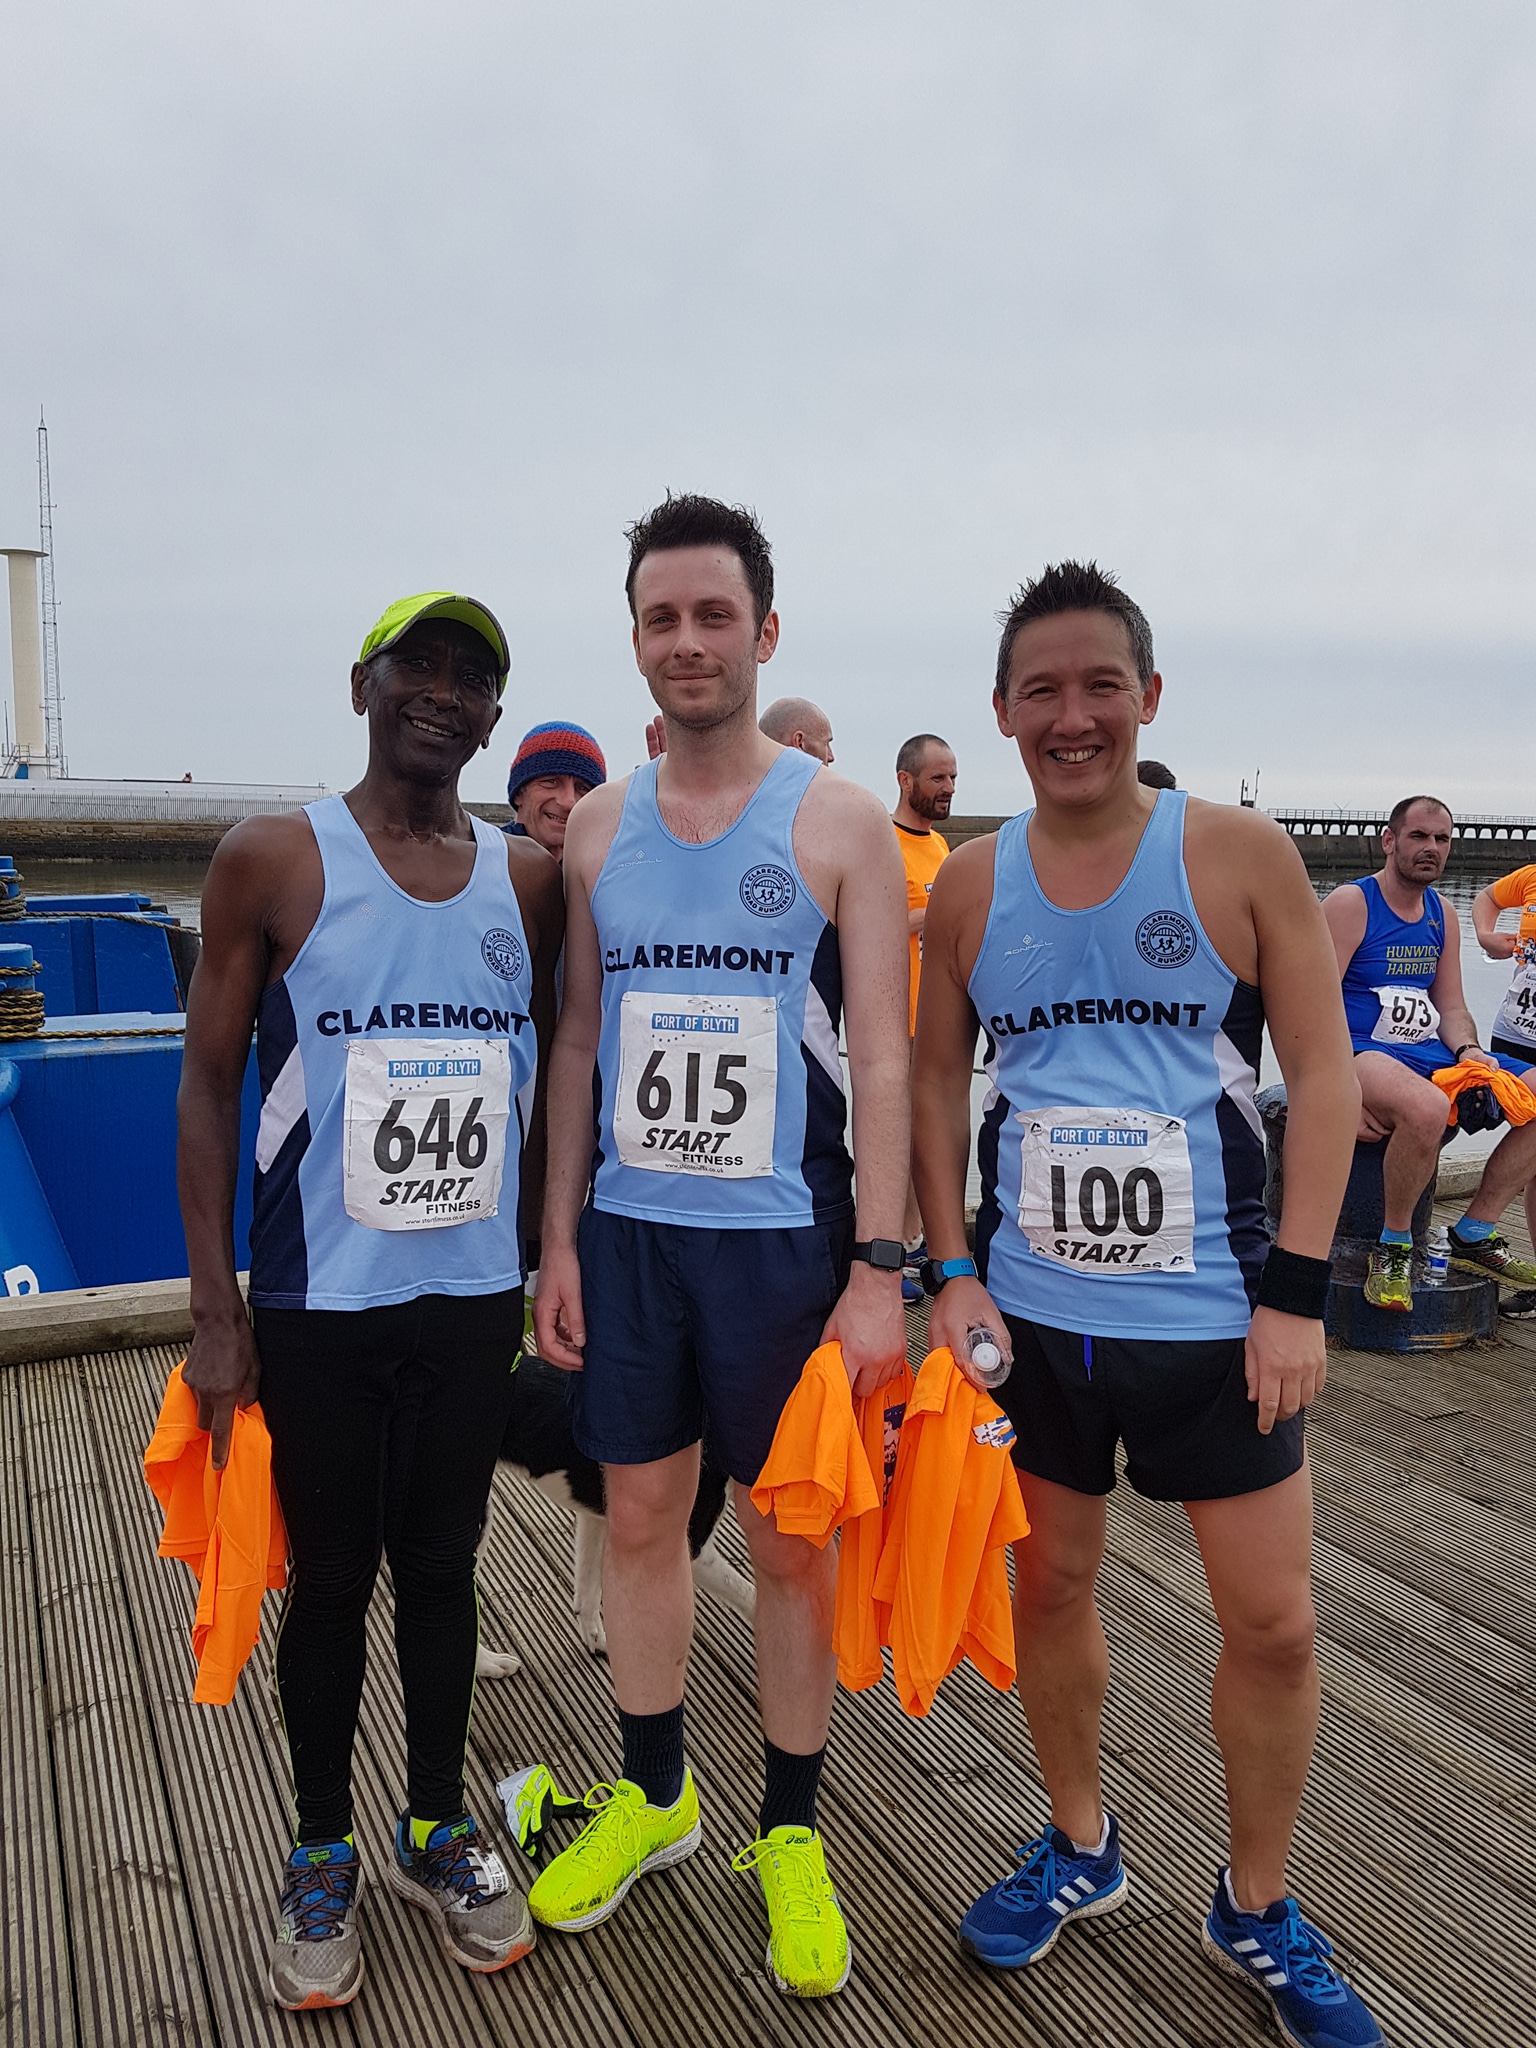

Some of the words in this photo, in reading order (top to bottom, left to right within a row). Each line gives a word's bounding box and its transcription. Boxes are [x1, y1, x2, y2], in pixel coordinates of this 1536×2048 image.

[748, 868, 790, 886] CLAREMONT
[744, 890, 758, 909] ROAD
[758, 895, 790, 913] RUNNERS
[1143, 914, 1190, 934] CLAREMONT
[486, 951, 500, 971] ROAD
[605, 944, 795, 976] CLAREMONT
[1140, 940, 1157, 960] ROAD
[1157, 943, 1191, 964] RUNNERS
[1386, 945, 1440, 958] HUNWICK
[316, 1002, 531, 1037] CLAREMONT
[655, 1015, 681, 1030] PORT
[685, 1016, 699, 1030] OF
[702, 1018, 736, 1032] BLYTH
[990, 998, 1207, 1037] CLAREMONT
[1391, 996, 1432, 1028] 673
[1388, 1025, 1424, 1039] START
[393, 1062, 424, 1076] PORT
[427, 1062, 443, 1075] OF
[446, 1061, 479, 1075] BLYTH
[636, 1049, 748, 1126] 615
[373, 1097, 488, 1175] 646
[642, 1127, 732, 1154] START
[1053, 1129, 1084, 1143] PORT
[1087, 1130, 1103, 1144] OF
[1107, 1131, 1144, 1145] BLYTH
[682, 1153, 744, 1166] FITNESS
[379, 1176, 475, 1206] START
[1050, 1164, 1164, 1237] 100
[426, 1199, 481, 1215] FITNESS
[1052, 1239, 1148, 1264] START
